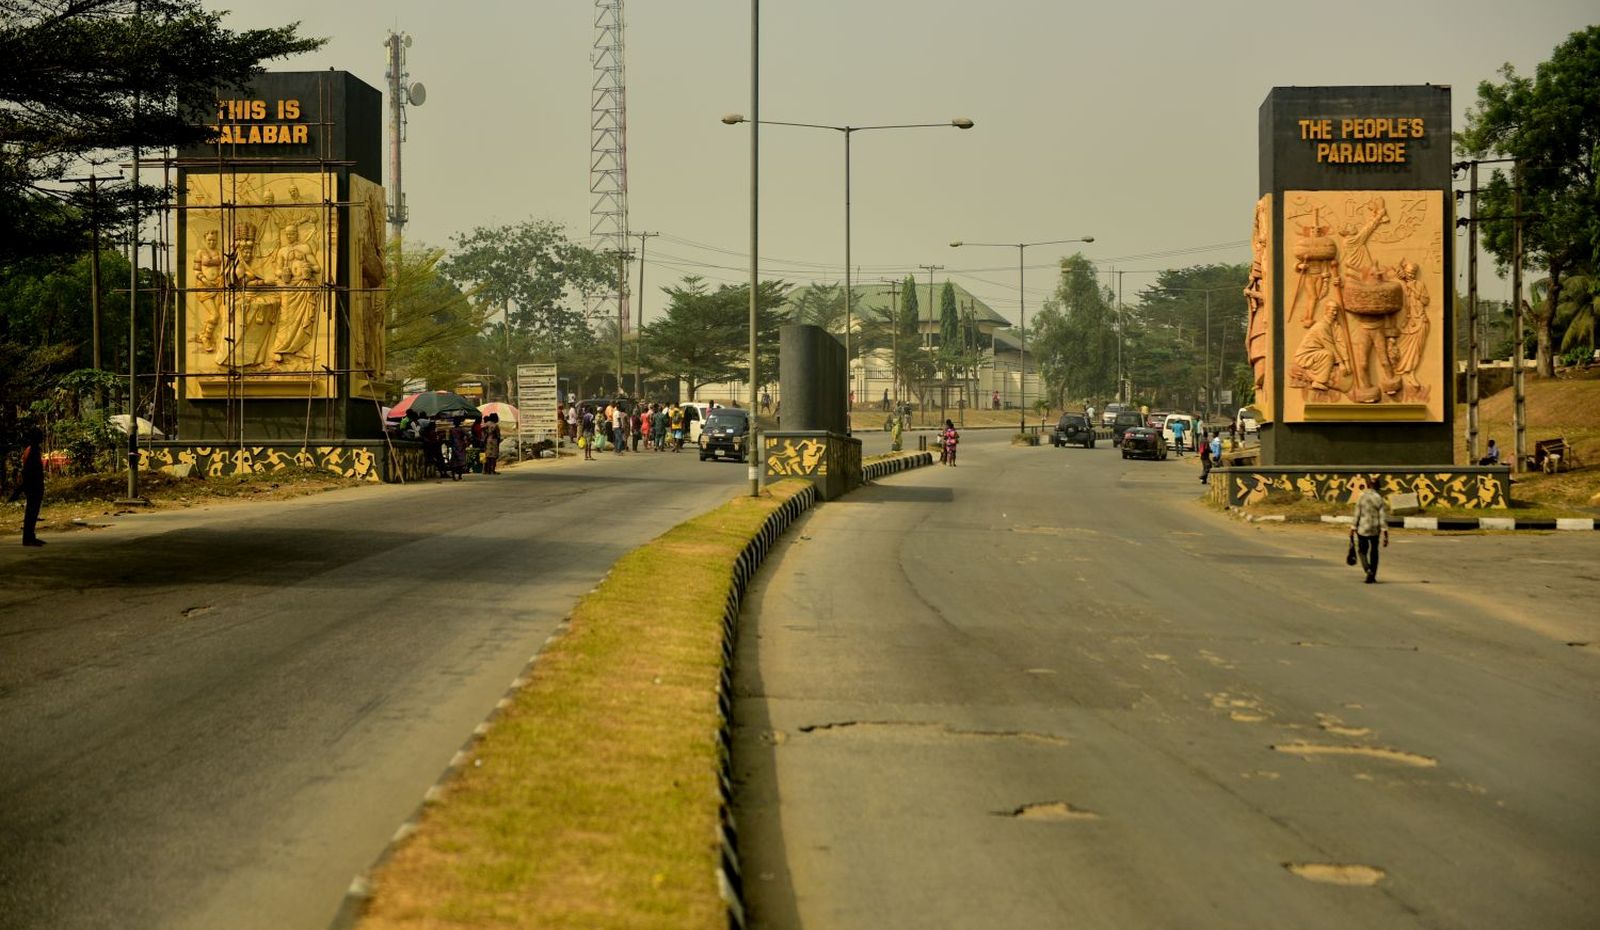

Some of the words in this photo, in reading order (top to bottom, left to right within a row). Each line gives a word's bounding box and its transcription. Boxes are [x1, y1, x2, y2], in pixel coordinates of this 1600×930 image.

[277, 100, 300, 119] IS
[1298, 119, 1332, 139] THE
[1341, 118, 1424, 139] PEOPLE'S
[1317, 142, 1406, 163] PARADISE
